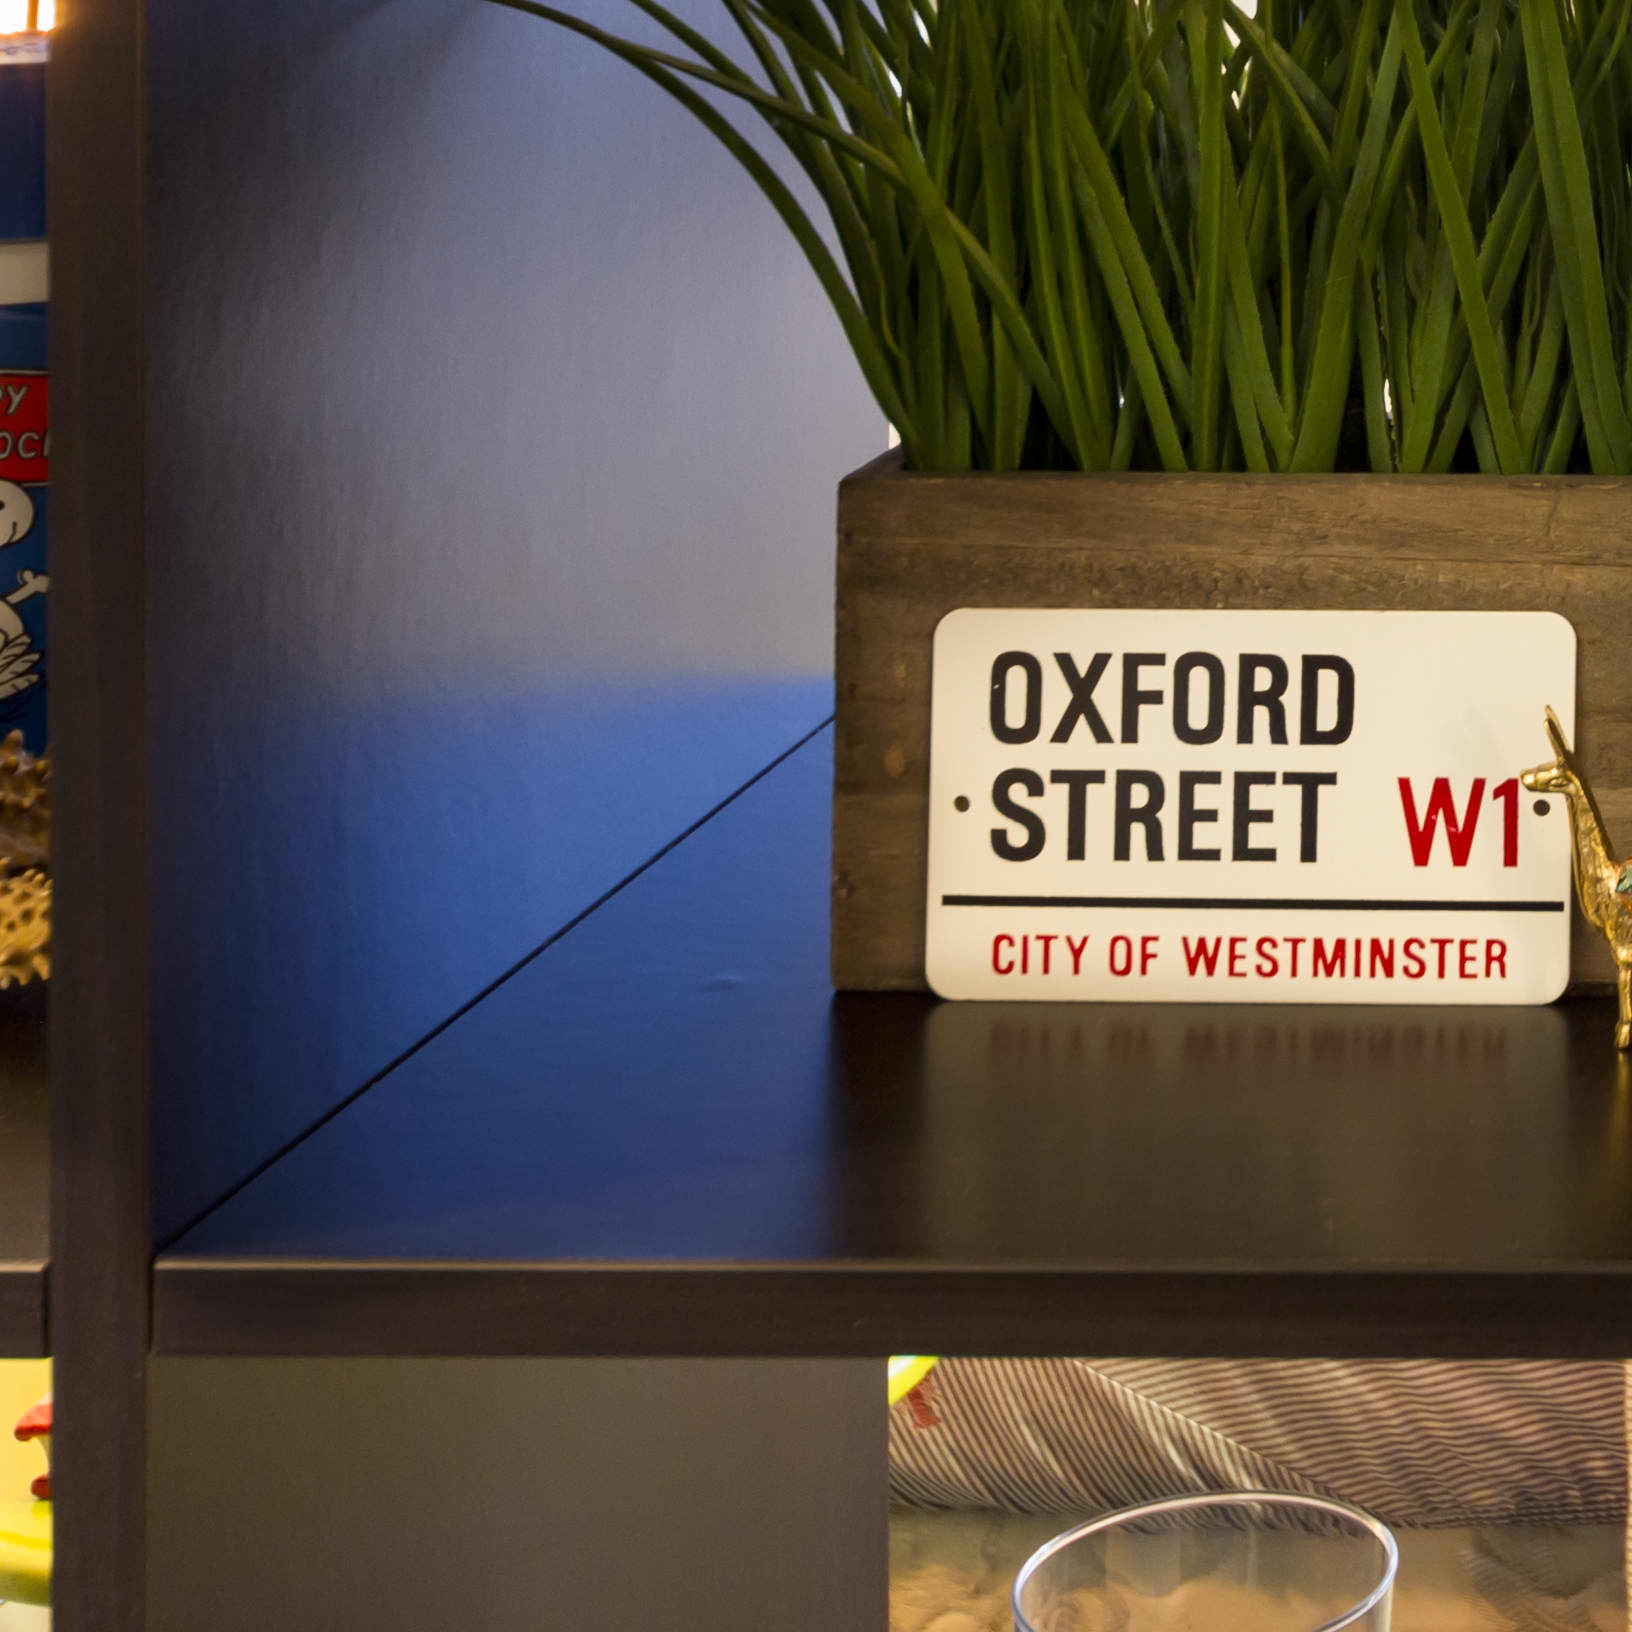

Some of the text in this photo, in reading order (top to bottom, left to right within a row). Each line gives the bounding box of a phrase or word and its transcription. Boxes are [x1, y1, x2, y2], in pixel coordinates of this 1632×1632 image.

[989, 650, 1356, 746] OXFORD
[990, 767, 1521, 869] STREET W1
[992, 933, 1508, 980] CITY OF WESTMINSTER
